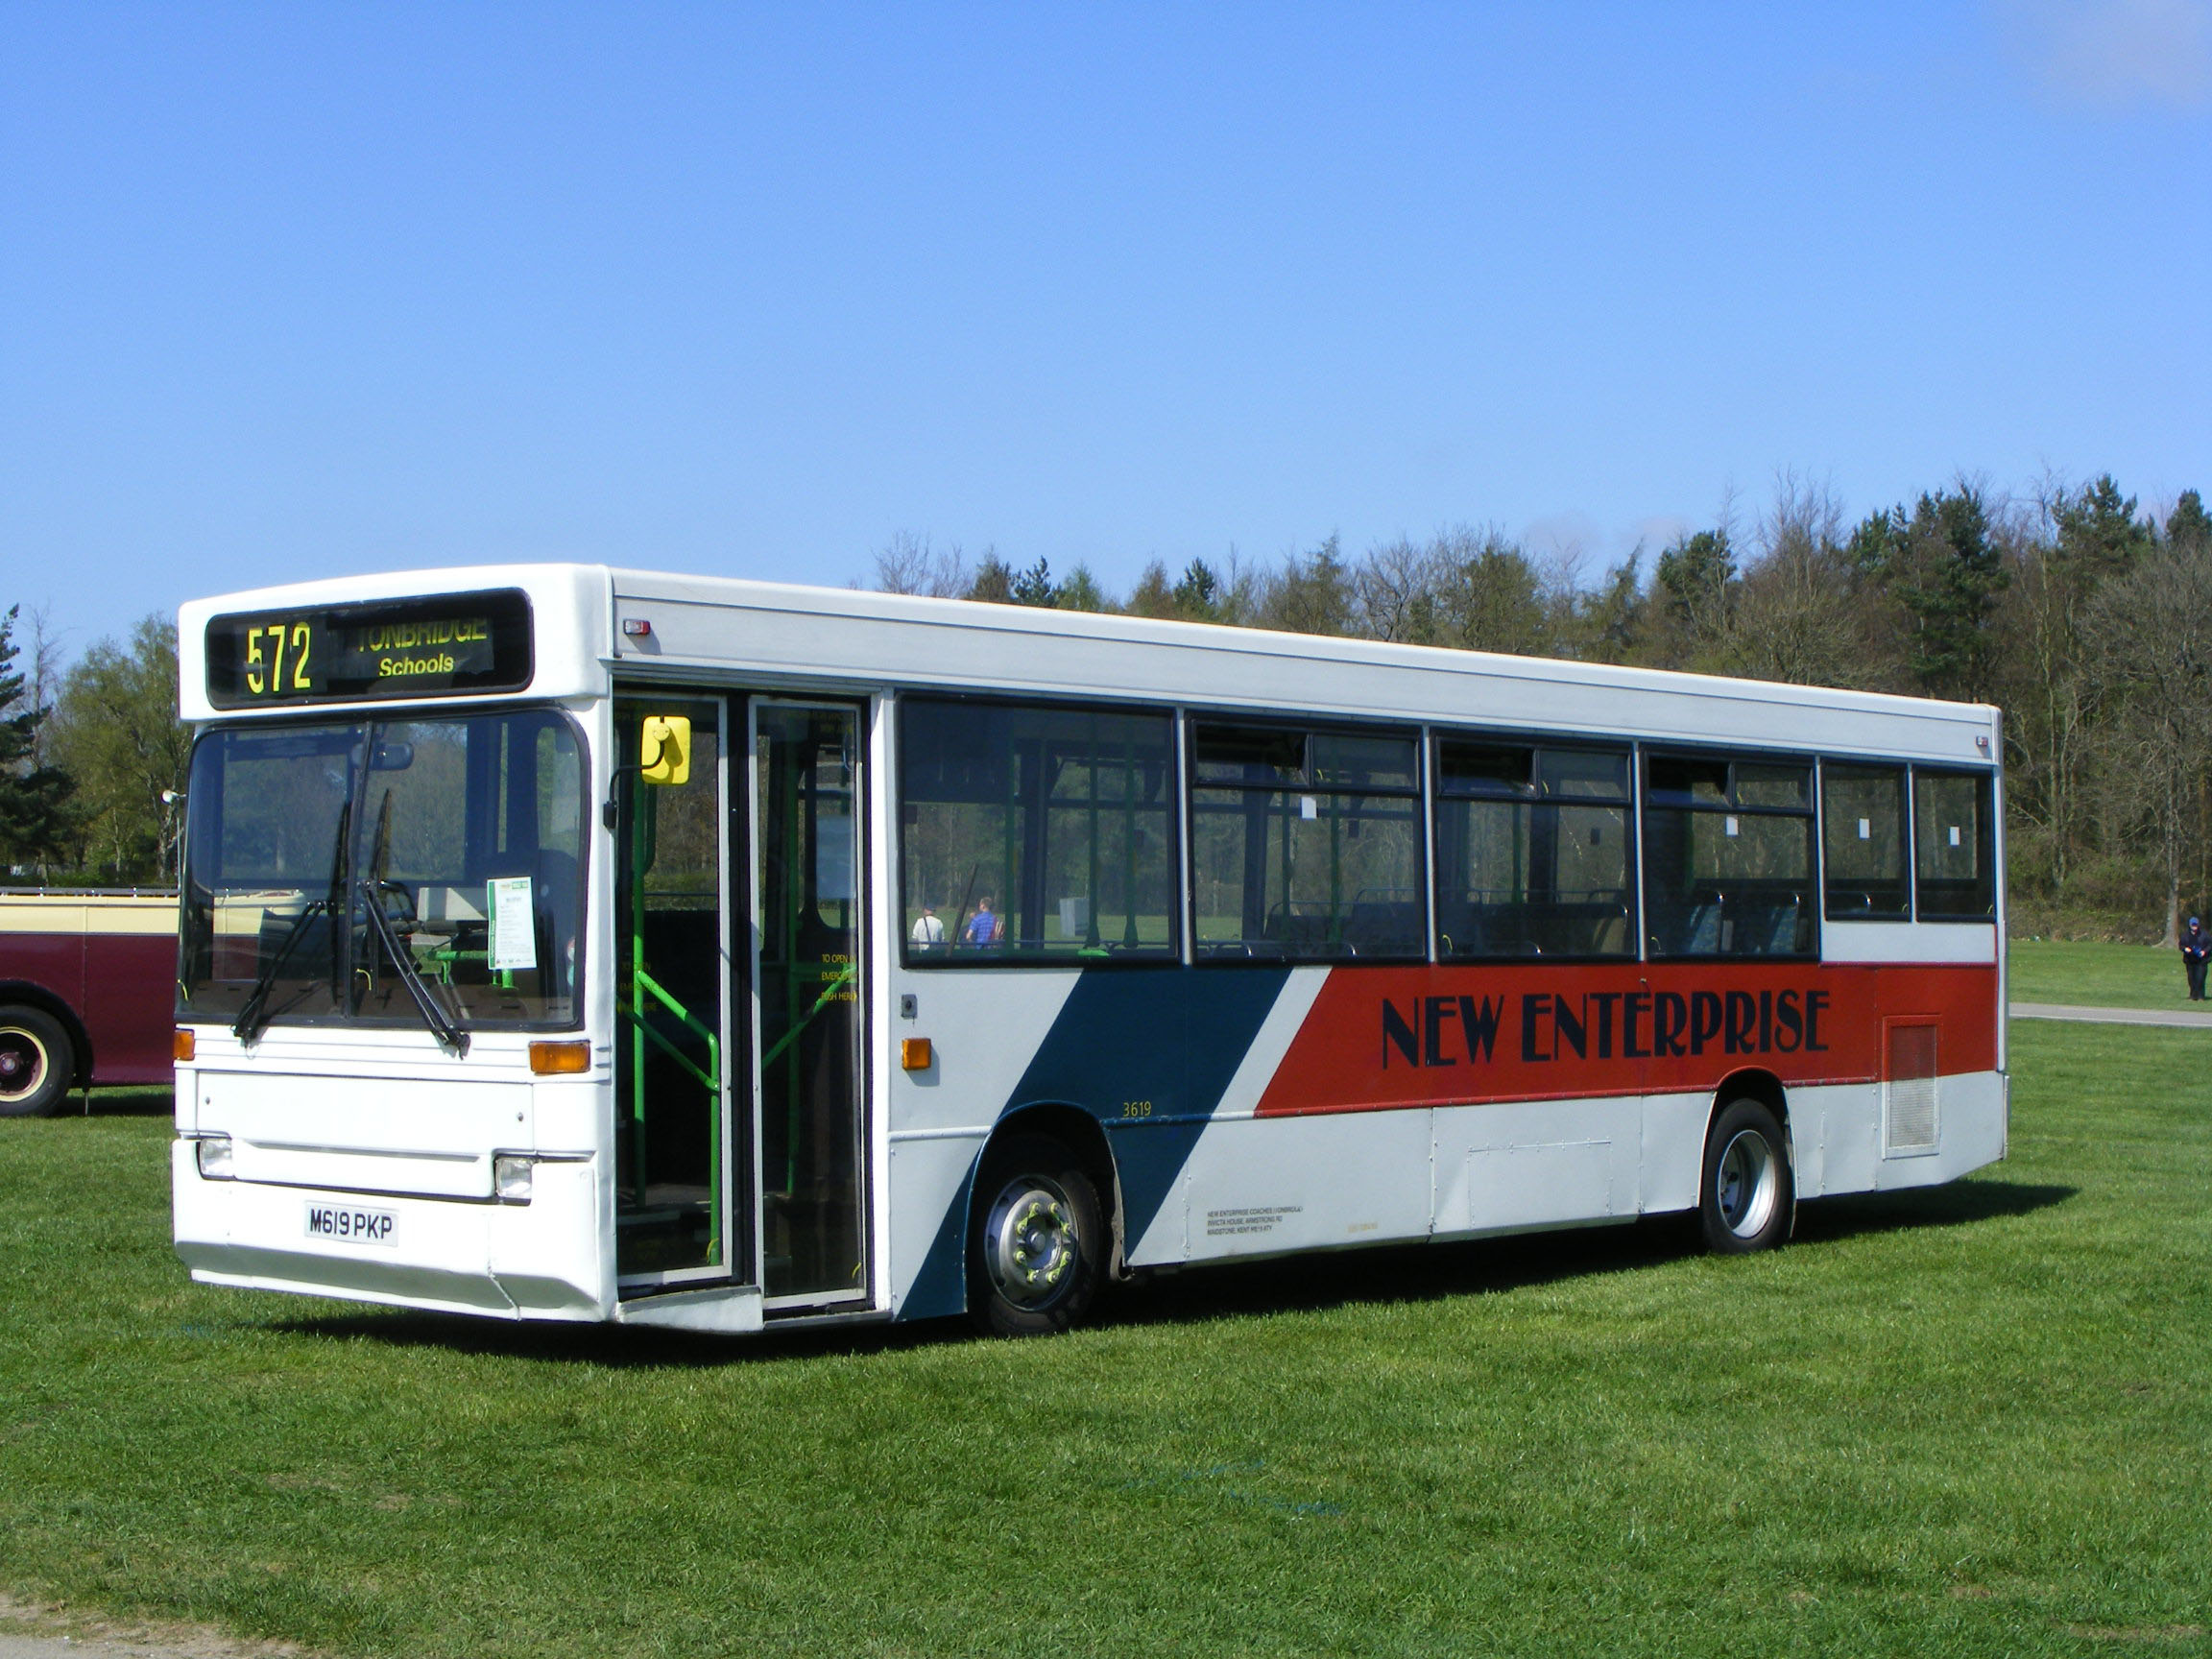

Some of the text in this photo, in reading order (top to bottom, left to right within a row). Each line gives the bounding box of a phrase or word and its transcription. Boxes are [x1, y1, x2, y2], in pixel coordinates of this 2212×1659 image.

[357, 617, 488, 652] TONBRIDGE
[247, 621, 311, 694] 572
[378, 652, 454, 677] Schools
[1382, 989, 1830, 1070] NEW ENTERPRISE
[1122, 1100, 1152, 1117] 3619
[310, 1208, 392, 1239] M619 PKP
